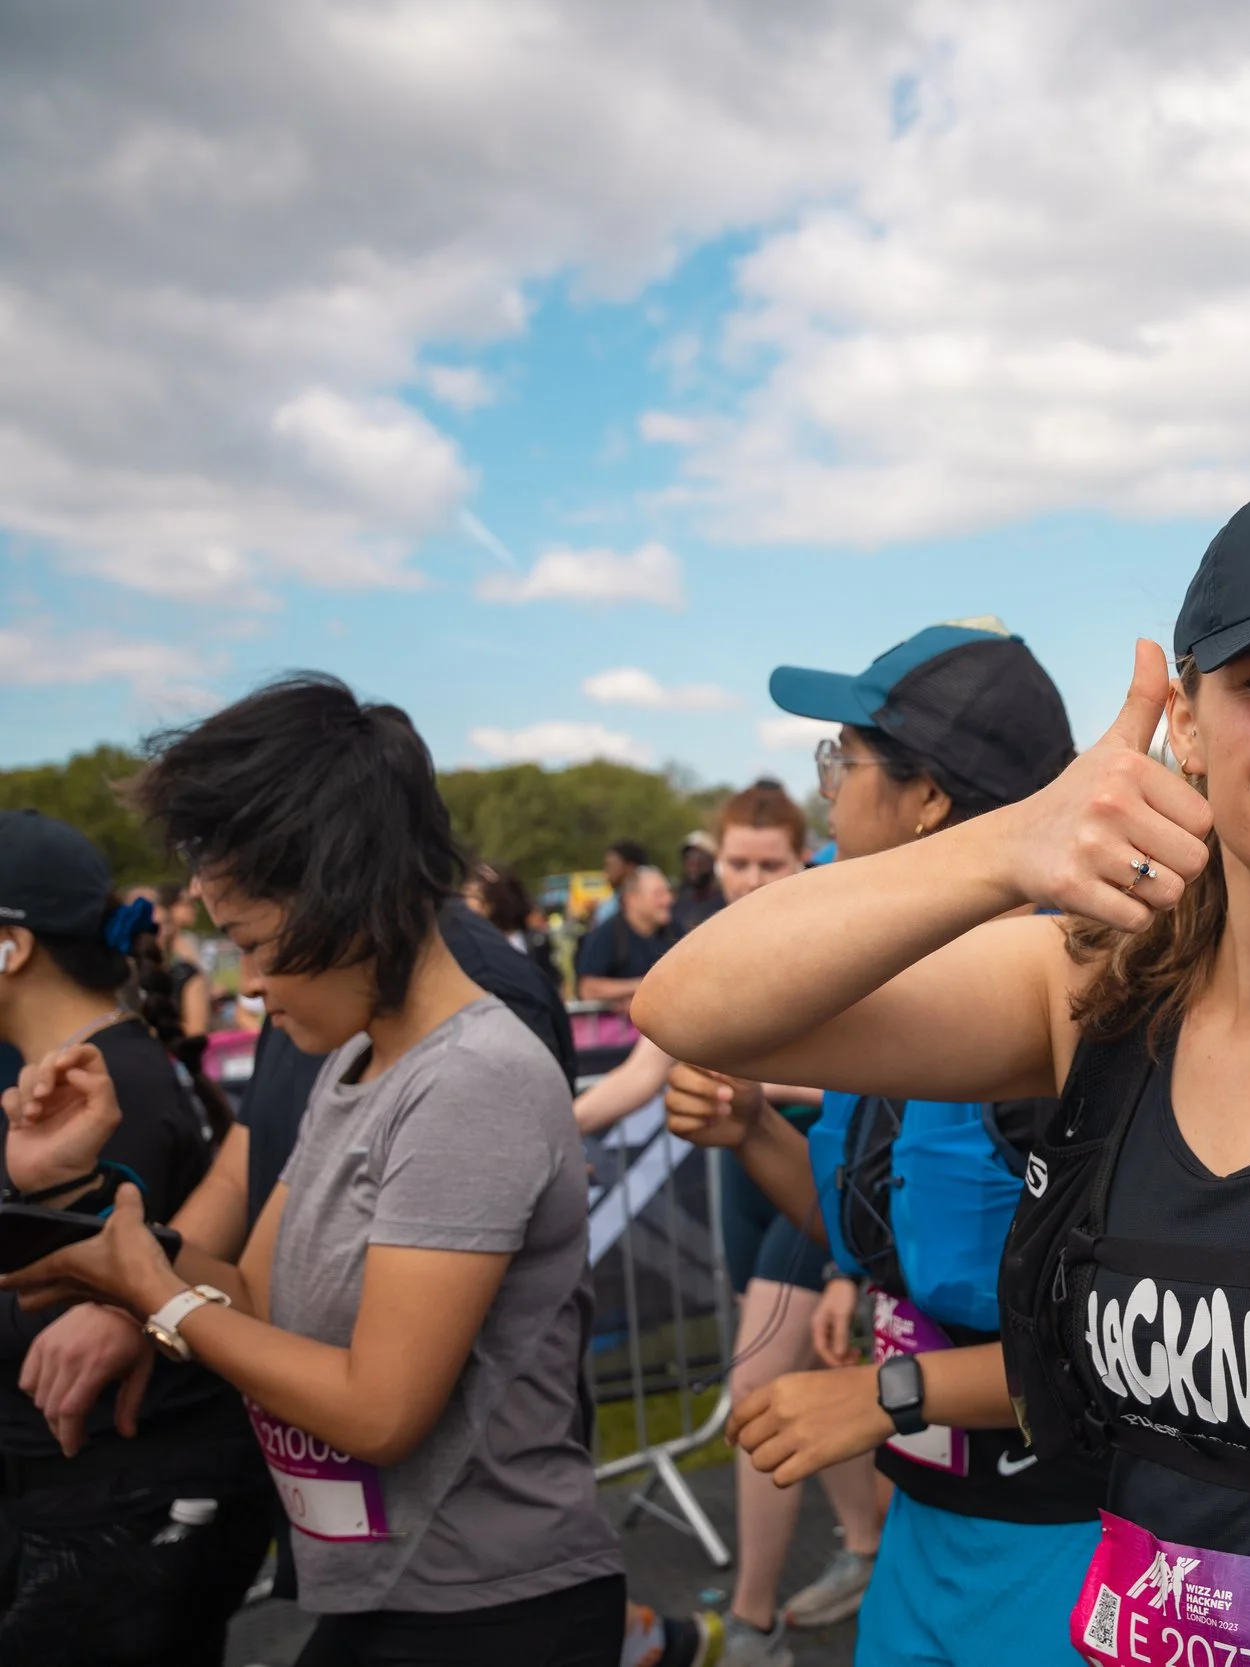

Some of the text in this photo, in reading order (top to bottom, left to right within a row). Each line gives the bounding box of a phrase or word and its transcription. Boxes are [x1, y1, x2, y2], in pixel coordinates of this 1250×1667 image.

[1185, 1583, 1233, 1600] WIZZ AIR
[1186, 1593, 1232, 1611] HACKNEY
[1186, 1603, 1210, 1616] HALF
[1186, 1612, 1239, 1632] LONDON 2023
[1129, 1611, 1152, 1663] E
